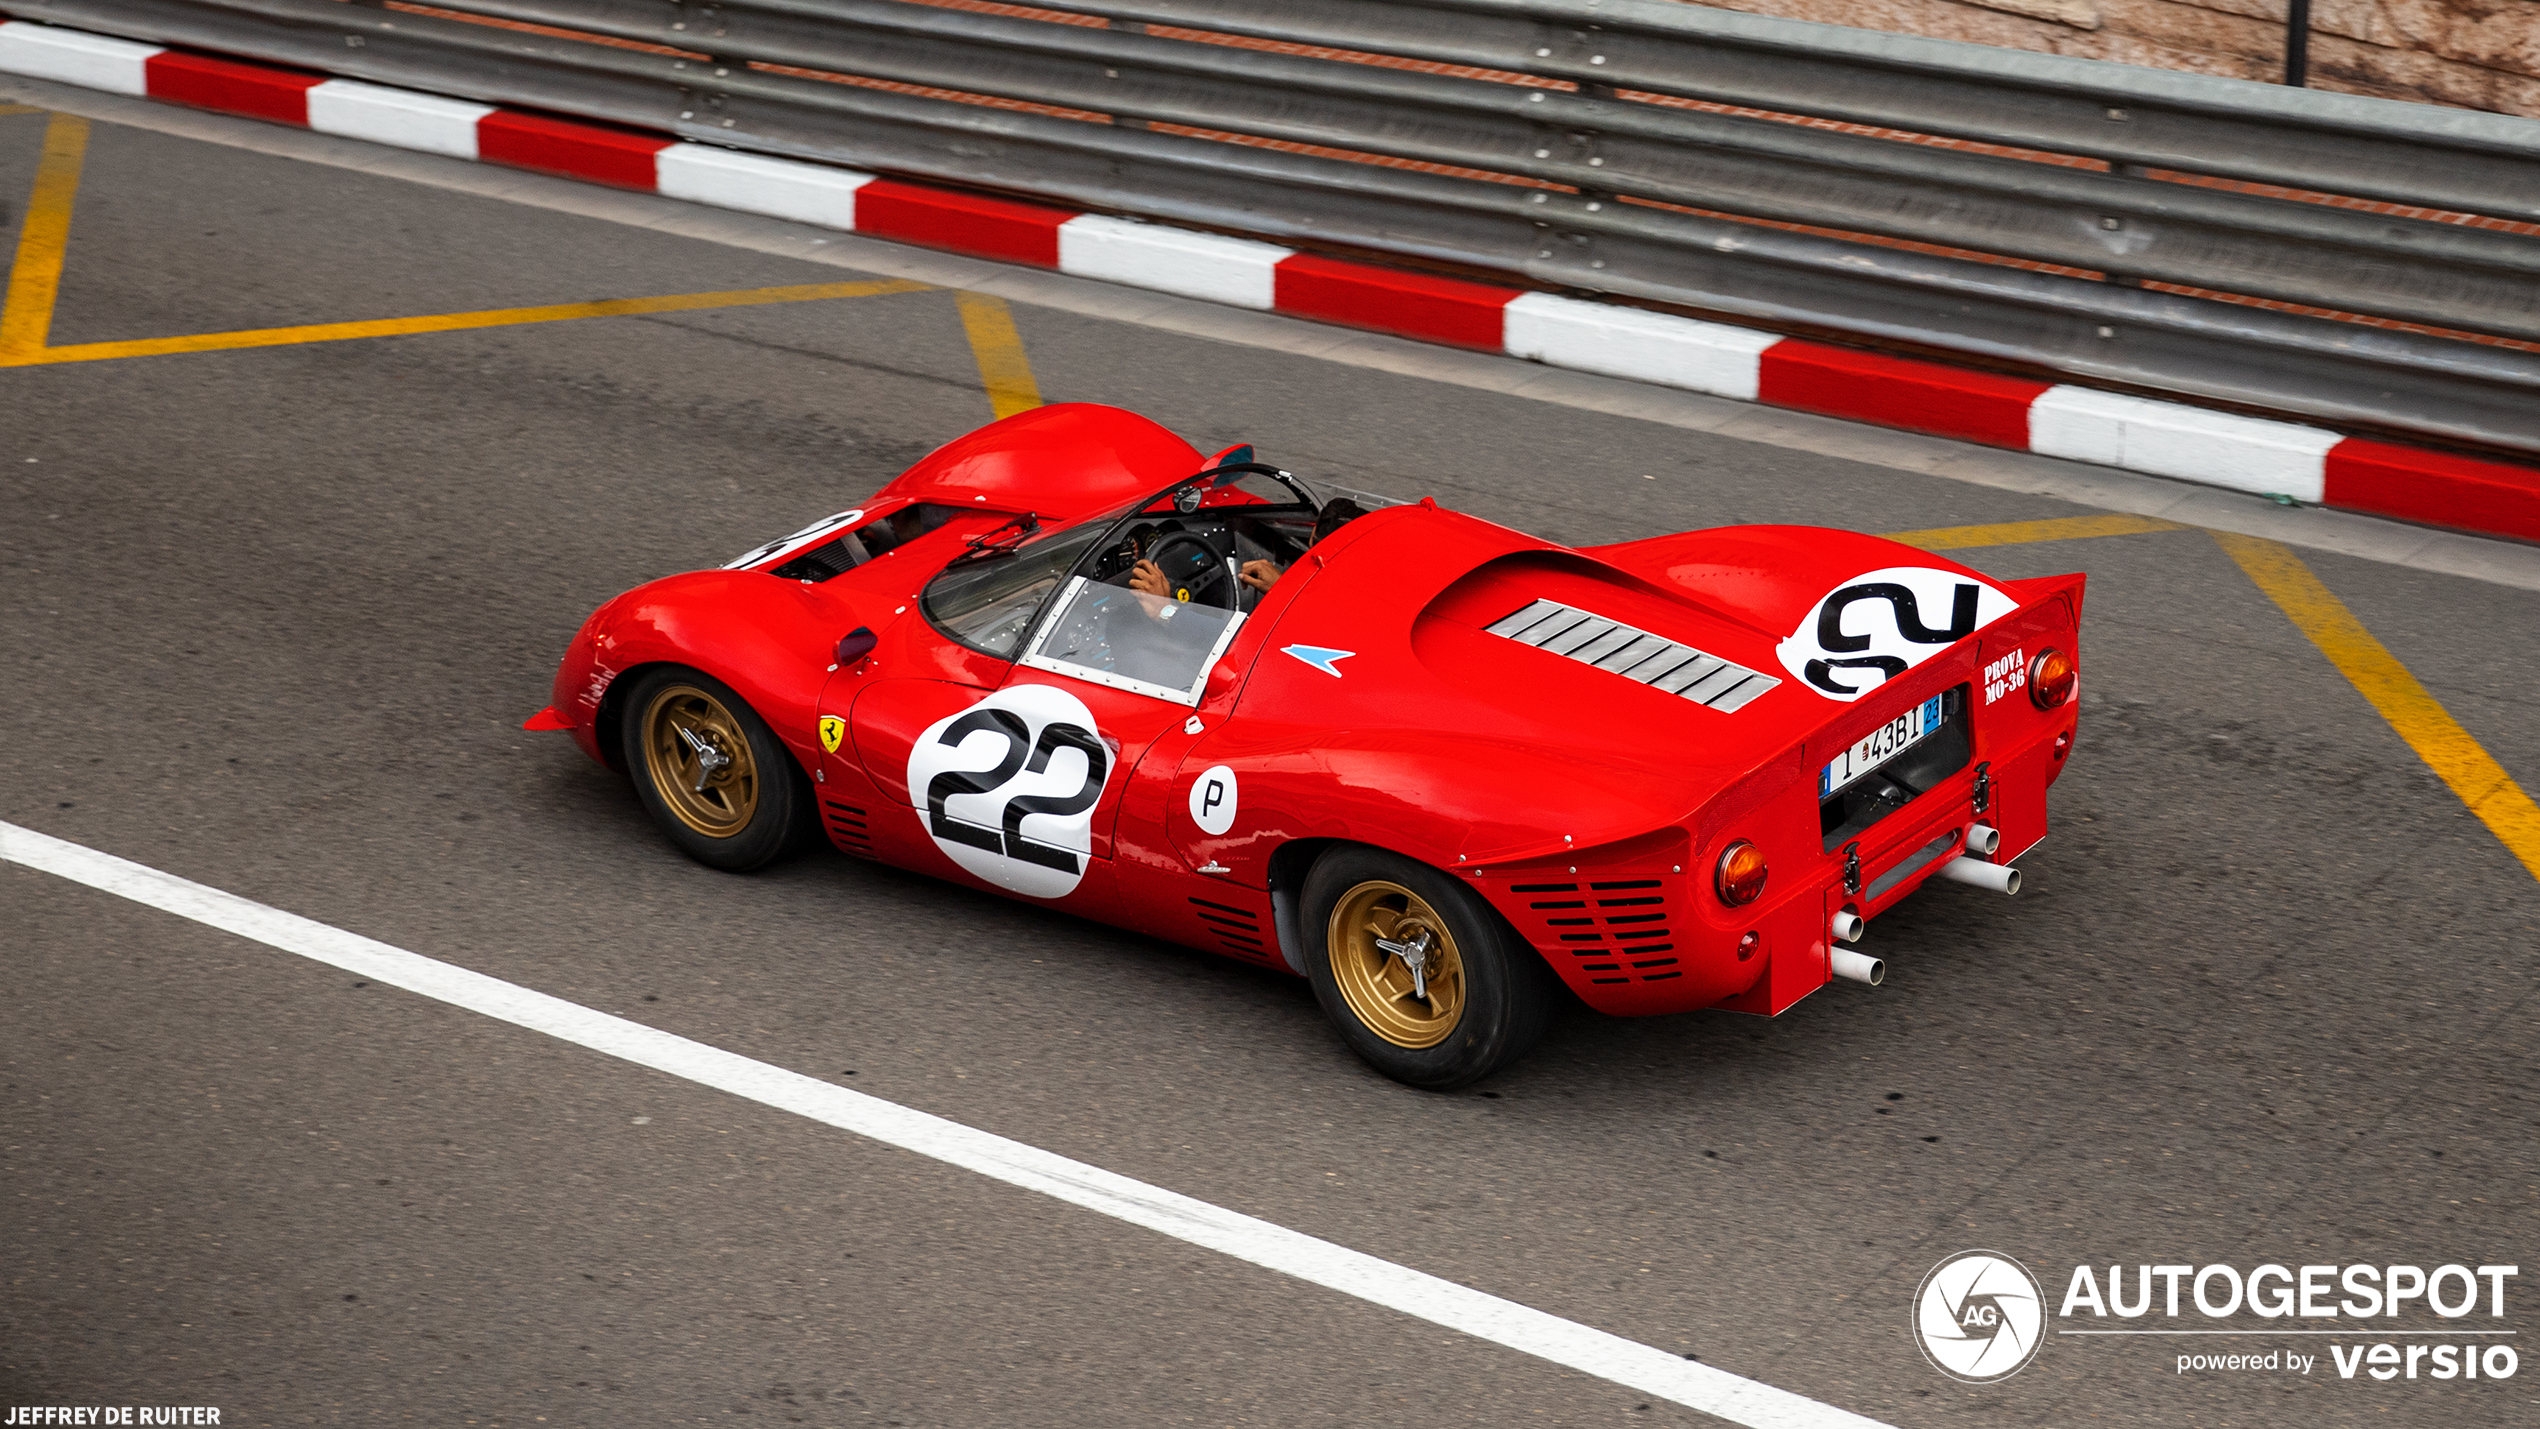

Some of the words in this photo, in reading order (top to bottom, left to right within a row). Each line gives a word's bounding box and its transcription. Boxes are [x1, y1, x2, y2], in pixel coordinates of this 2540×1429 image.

[1984, 648, 2025, 686] PROVA
[1985, 668, 2026, 706] MO-36
[1871, 707, 1919, 760] 43BI
[1925, 699, 1940, 725] 23
[927, 708, 1107, 876] 22
[1202, 779, 1225, 818] P
